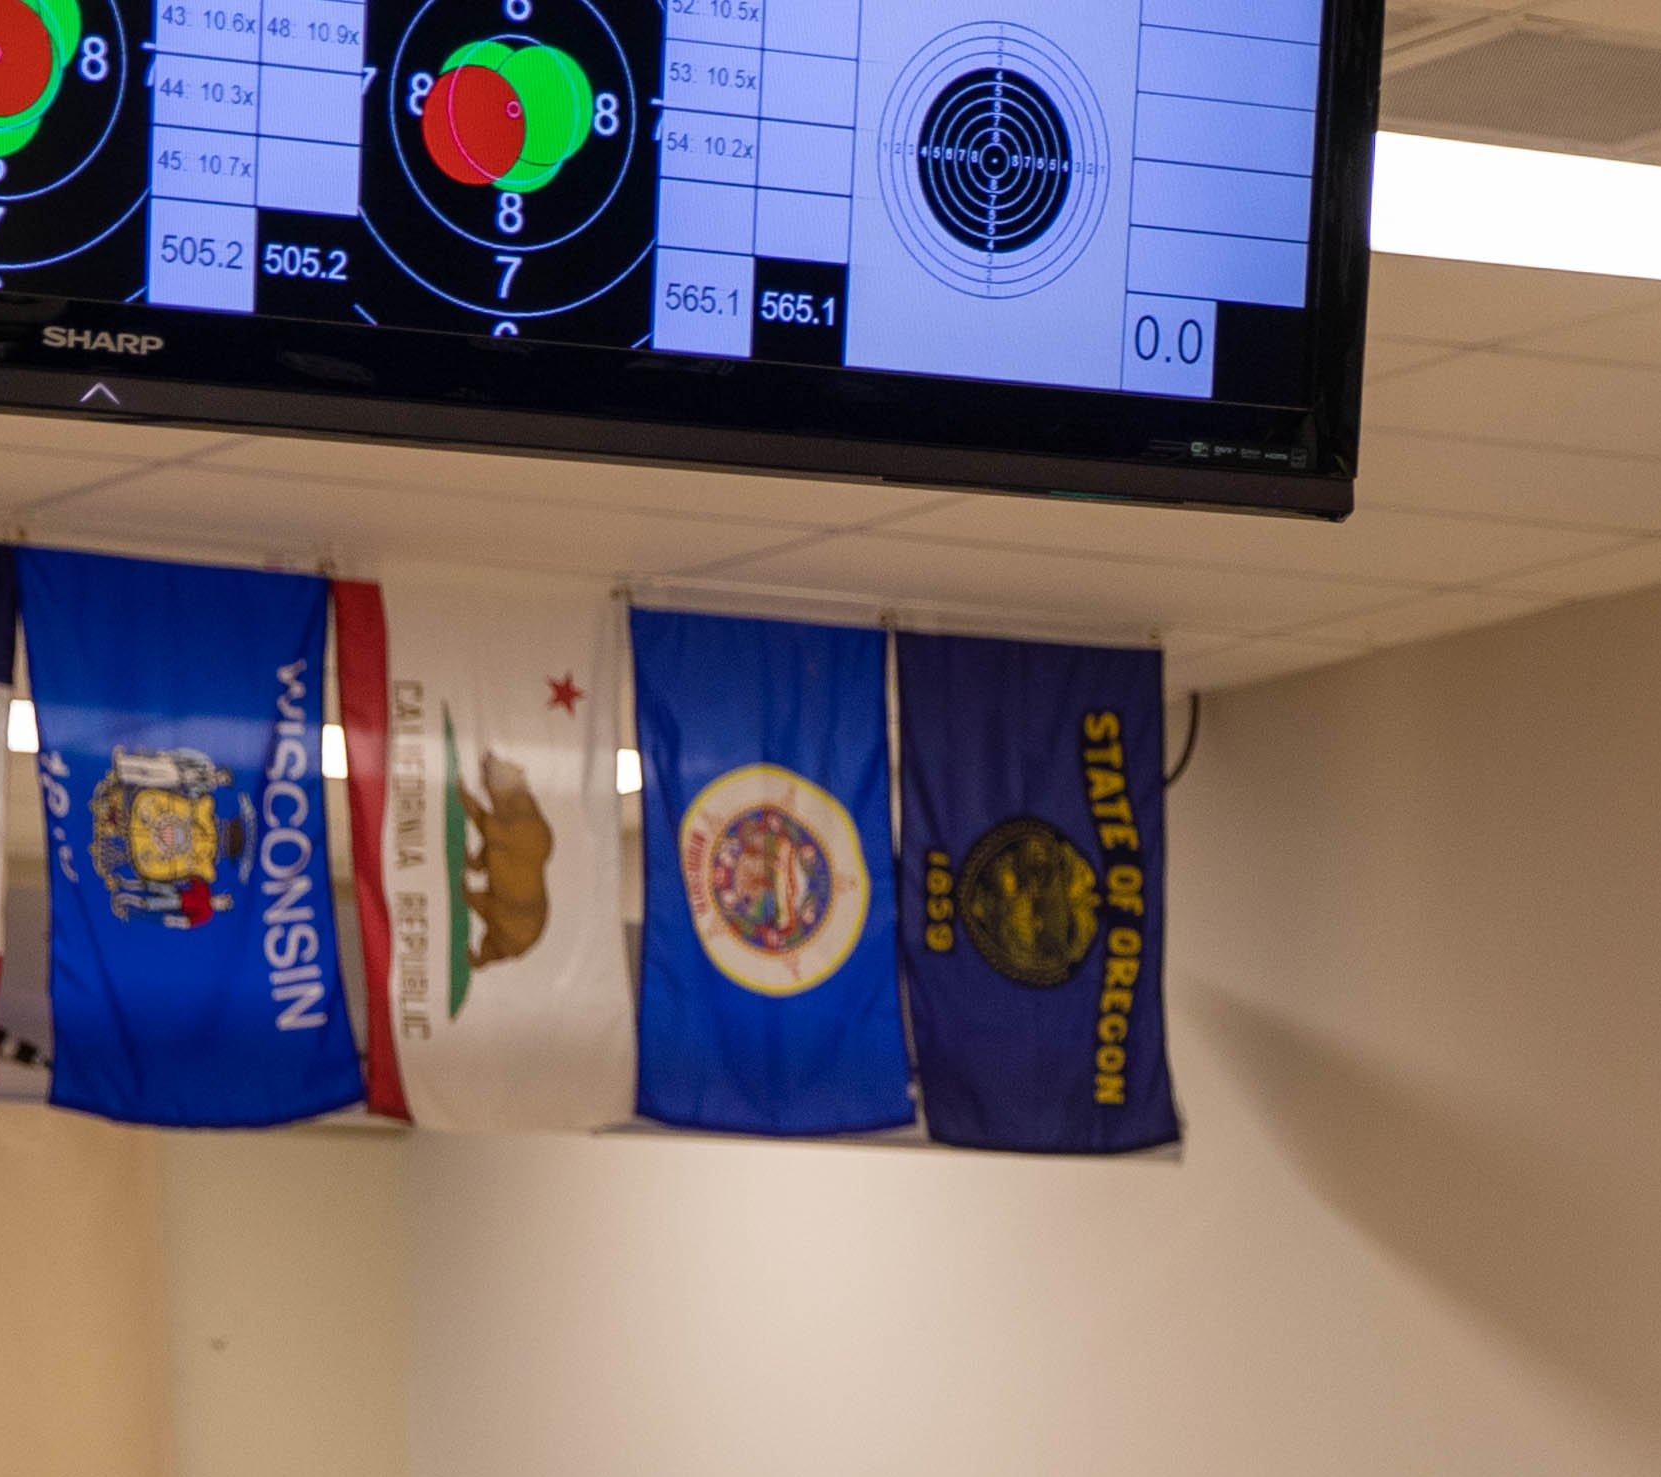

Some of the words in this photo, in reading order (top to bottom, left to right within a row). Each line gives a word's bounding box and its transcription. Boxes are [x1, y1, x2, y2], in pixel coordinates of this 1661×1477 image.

[77, 36, 109, 82] 8
[593, 93, 619, 137] 8
[495, 193, 524, 234] 8
[160, 234, 243, 270] 505.2
[264, 243, 347, 281] 505.2
[494, 256, 523, 299] 7
[665, 283, 739, 316] 565.1
[760, 292, 835, 326] 565.1
[42, 326, 164, 355] SHARP
[1135, 315, 1203, 364] 0.0
[1085, 711, 1140, 853] STATE
[261, 658, 329, 1031] WISCONSIN
[1104, 863, 1145, 917] OF
[1094, 928, 1145, 1105] OREGON
